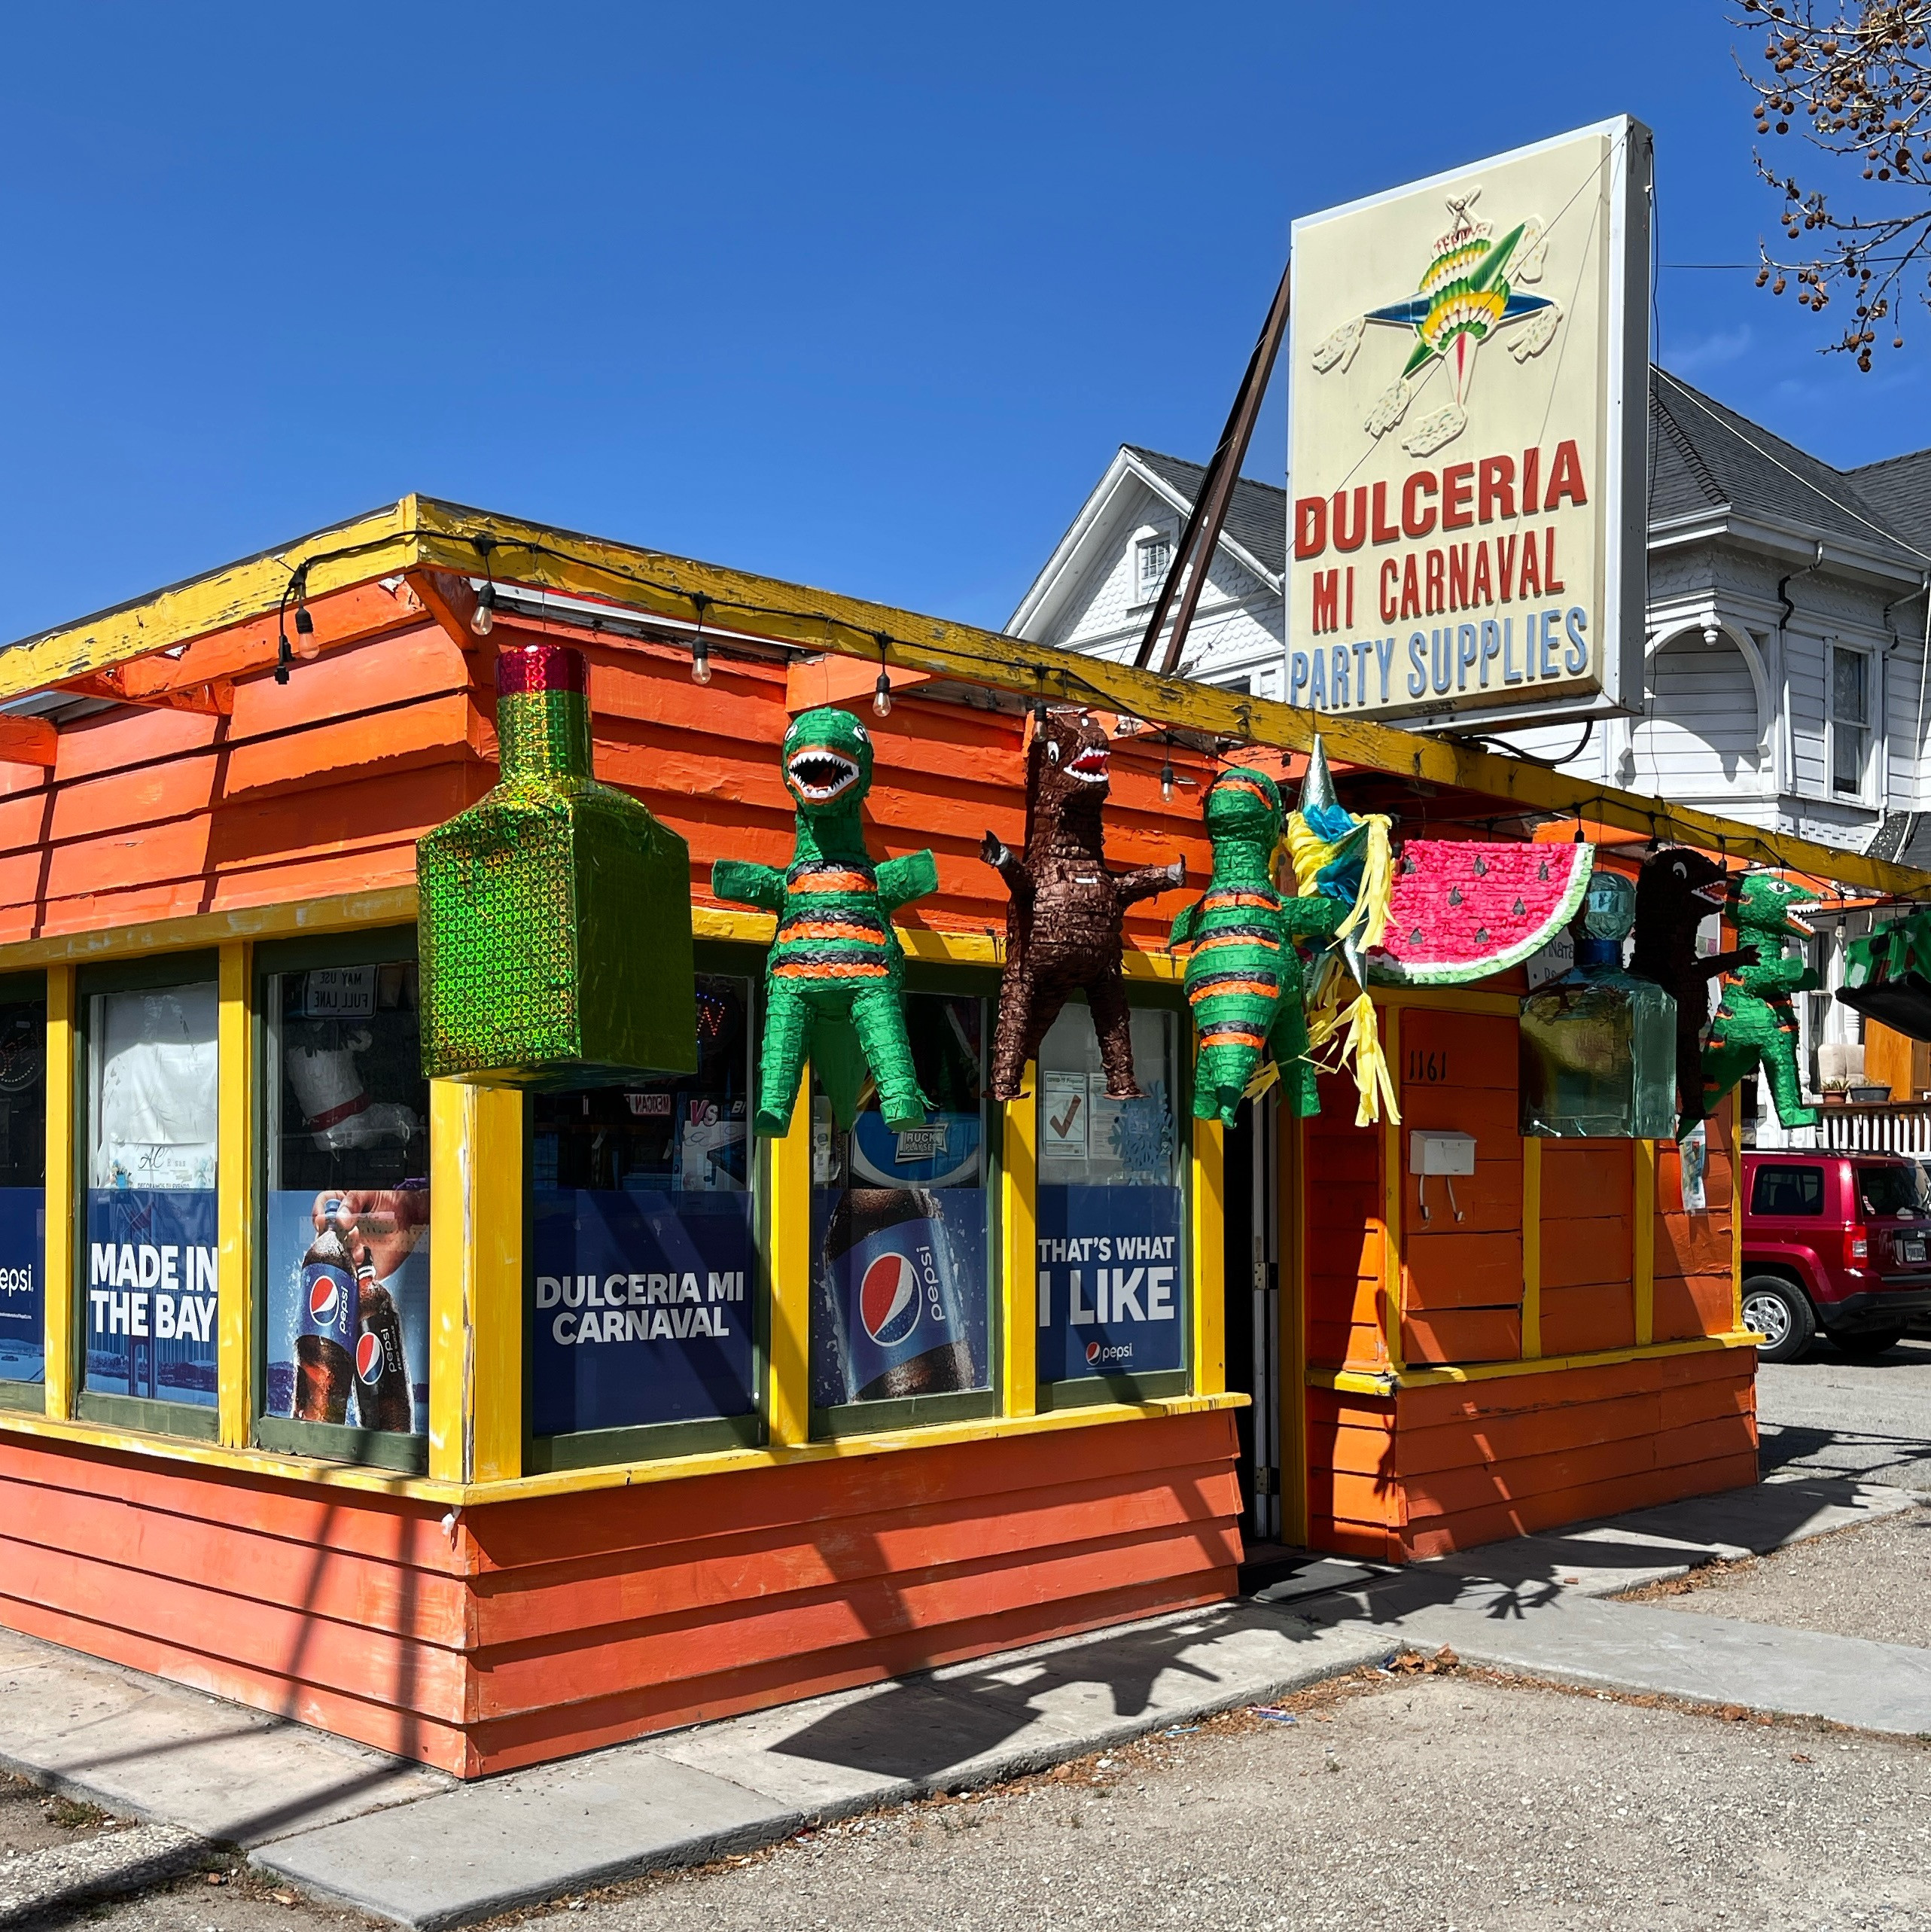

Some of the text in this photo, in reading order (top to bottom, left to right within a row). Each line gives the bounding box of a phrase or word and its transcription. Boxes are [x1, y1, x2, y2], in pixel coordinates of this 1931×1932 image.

[1295, 439, 1588, 561] DULCERIA
[1313, 526, 1565, 634] MI CARNAVAL
[1291, 606, 1588, 710] PARTY SUPPLIES
[1409, 1050, 1446, 1082] 1161
[91, 1243, 218, 1292] MADE IN
[1038, 1236, 1175, 1263] THAT'S WHAT
[0, 1264, 32, 1297] epsi
[536, 1272, 744, 1309] DULCERIA MI
[915, 1246, 946, 1321] pepsi
[1039, 1266, 1174, 1327] I LIKE
[90, 1290, 217, 1342] THE BAY
[339, 1285, 349, 1335] pepsi
[553, 1307, 729, 1345] CARNAVAL
[380, 1327, 397, 1373] pepsi
[1102, 1342, 1133, 1361] pepsi
